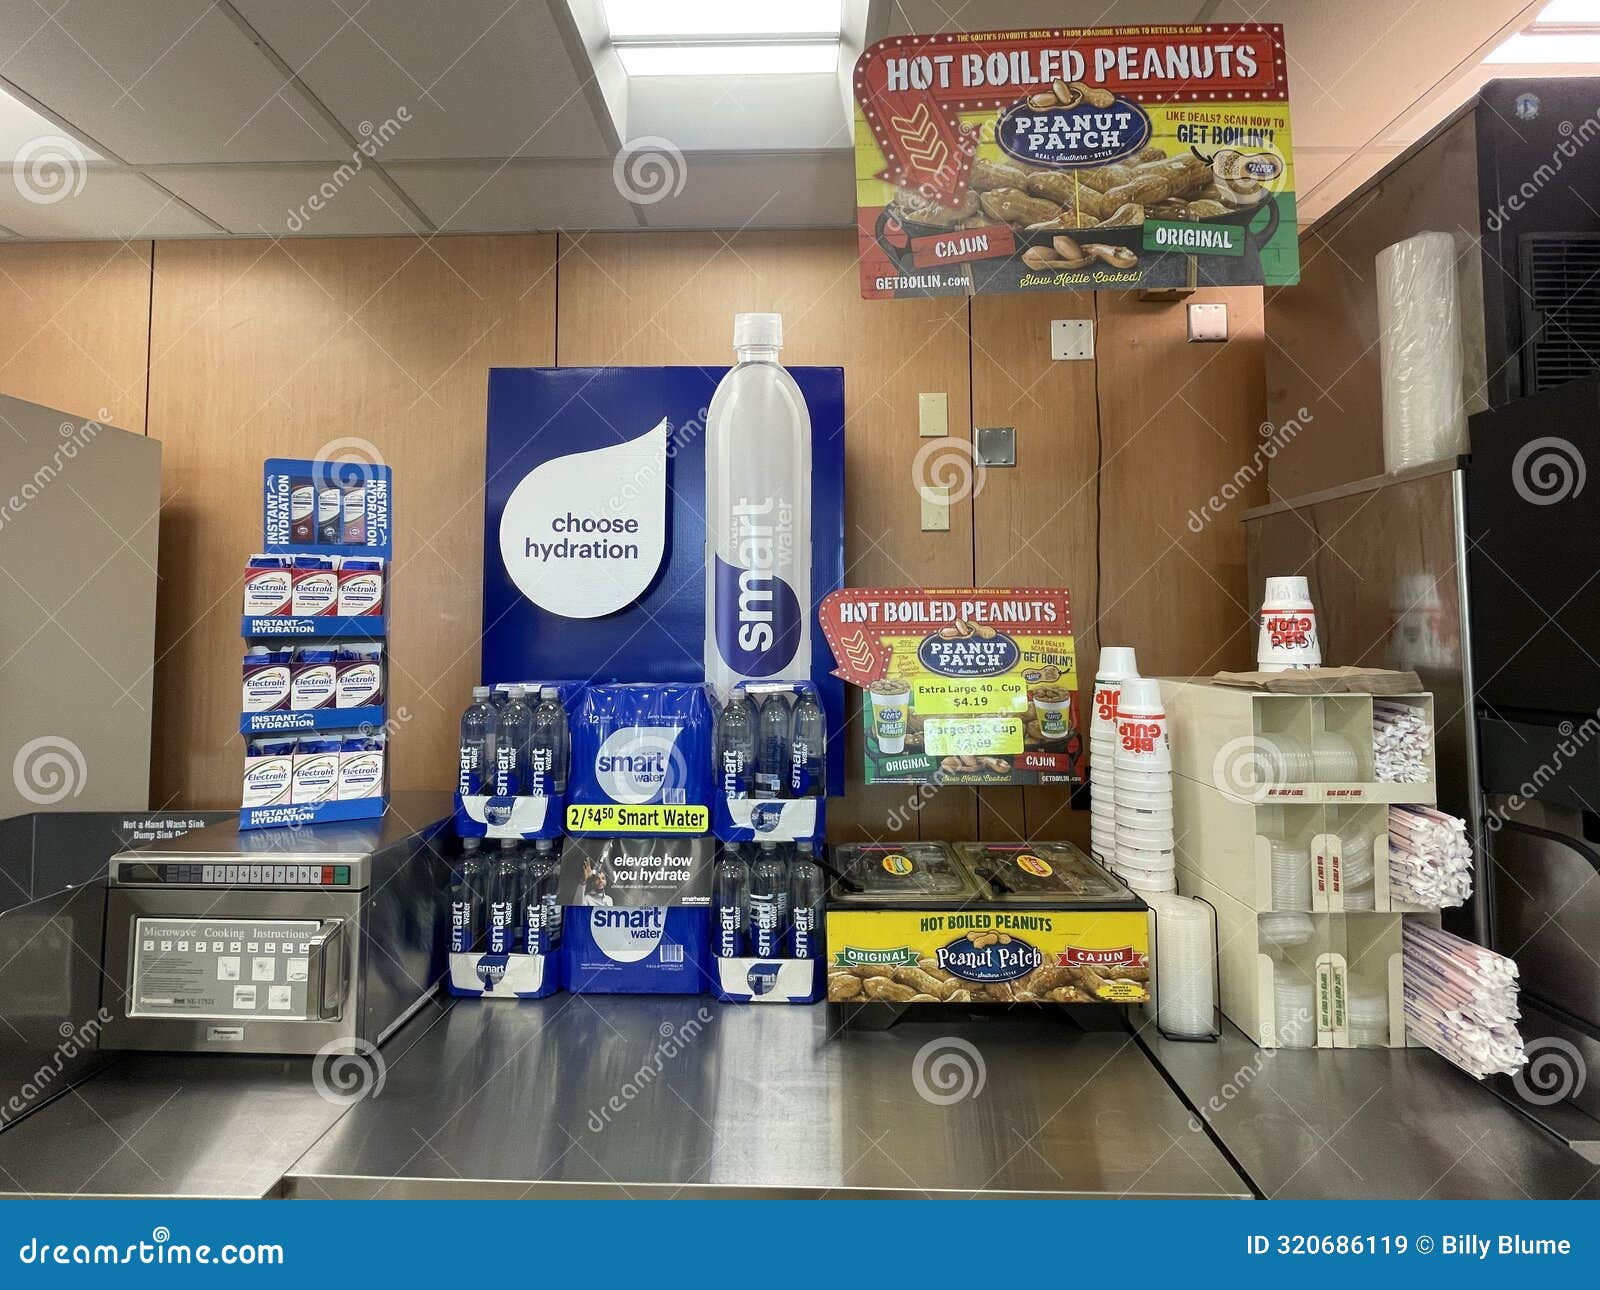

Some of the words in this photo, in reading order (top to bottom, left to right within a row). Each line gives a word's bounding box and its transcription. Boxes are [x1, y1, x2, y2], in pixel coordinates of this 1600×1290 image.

[998, 32, 1028, 40] FAVORITE
[1030, 31, 1051, 39] SNACK
[886, 55, 954, 91] HOT
[962, 49, 1085, 88] BOILED
[1095, 45, 1257, 83] PEANUTS
[1015, 113, 1131, 134] PEANUT
[1166, 111, 1186, 121] LIKE
[1188, 112, 1222, 123] DEALS?
[1224, 115, 1248, 125] SCAN
[1250, 117, 1271, 127] NOW
[1274, 119, 1285, 128] TO
[1028, 131, 1120, 151] PATCH
[1177, 124, 1208, 144] GET
[1212, 126, 1275, 148] BOILIN'!
[1035, 152, 1051, 160] REAL
[1094, 150, 1113, 159] STYLE
[1155, 227, 1233, 249] ORIGINAL
[935, 235, 988, 258] CAJUN
[1020, 273, 1051, 288] Slow
[1053, 272, 1091, 287] Kettle
[1093, 271, 1143, 284] Cooked!
[278, 474, 289, 545] HYDRATION
[367, 479, 377, 547] HYDRATION
[376, 480, 387, 530] INSTANT
[267, 493, 278, 545] INSTANT
[551, 512, 639, 534] choose
[772, 498, 793, 568] water
[525, 538, 639, 562] hydration
[732, 497, 774, 652] smart
[248, 583, 288, 592] Electrolit
[295, 584, 334, 593] Electrolit
[341, 585, 377, 593] Electrolit
[840, 602, 880, 623] HOT
[884, 601, 957, 622] BOILED
[961, 601, 1057, 622] PEANUTS
[931, 642, 1007, 655] PEANUT
[939, 654, 1000, 666] PATCH
[1023, 652, 1040, 662] GET
[247, 680, 287, 688] Electrolit
[295, 678, 333, 686] Electrolit
[340, 676, 376, 684] Electrolit
[919, 685, 946, 694] Extra
[948, 685, 977, 694] Large
[1001, 684, 1021, 693] Cup
[954, 697, 988, 708] $4.19
[251, 714, 297, 722] INSTANT
[251, 720, 314, 730] HYDRATION
[589, 713, 600, 724] 12
[993, 724, 1017, 735] Cup
[1119, 723, 1161, 738] GULP
[545, 748, 553, 771] water
[598, 752, 664, 773] smart
[792, 742, 802, 789] smart
[886, 757, 930, 772] ORIGINAL
[1026, 756, 1056, 767] CAJUN
[248, 772, 288, 781] Electrolit
[296, 769, 334, 777] Electrolit
[343, 767, 379, 775] Electrolit
[460, 747, 471, 796] smart
[497, 747, 509, 796] smart
[533, 748, 545, 797] smart
[634, 774, 664, 783] water
[724, 750, 737, 800] smart
[251, 808, 298, 817] INSTANT
[251, 813, 314, 825] HYDRATION
[618, 809, 659, 827] Smart
[663, 809, 705, 827] Water
[123, 821, 136, 829] Not
[145, 820, 164, 829] Hand
[166, 820, 187, 828] Wash
[188, 820, 205, 828] Sink
[134, 831, 155, 840] Dump
[156, 831, 173, 839] Sink
[614, 853, 662, 866] elevate
[663, 853, 692, 866] how
[613, 872, 637, 883] you
[639, 868, 691, 883] hydrate
[463, 902, 471, 924] water
[594, 907, 662, 928] smart
[452, 901, 463, 952] smart
[492, 902, 505, 953] smart
[527, 904, 540, 955] smart
[757, 903, 770, 957] smart
[920, 917, 944, 932] HOT
[948, 915, 991, 930] BOILED
[996, 915, 1052, 932] PEANUTS
[144, 927, 197, 937] Microwave
[204, 928, 245, 940] Cooking
[253, 929, 309, 938] Instructions
[631, 930, 662, 939] water
[721, 906, 734, 958] smart
[794, 906, 808, 959] smart
[848, 950, 906, 963] ORIGINAL
[937, 947, 992, 968] Peanut
[998, 947, 1041, 968] Patch
[1077, 951, 1125, 963] CAJUN
[477, 964, 505, 973] smart
